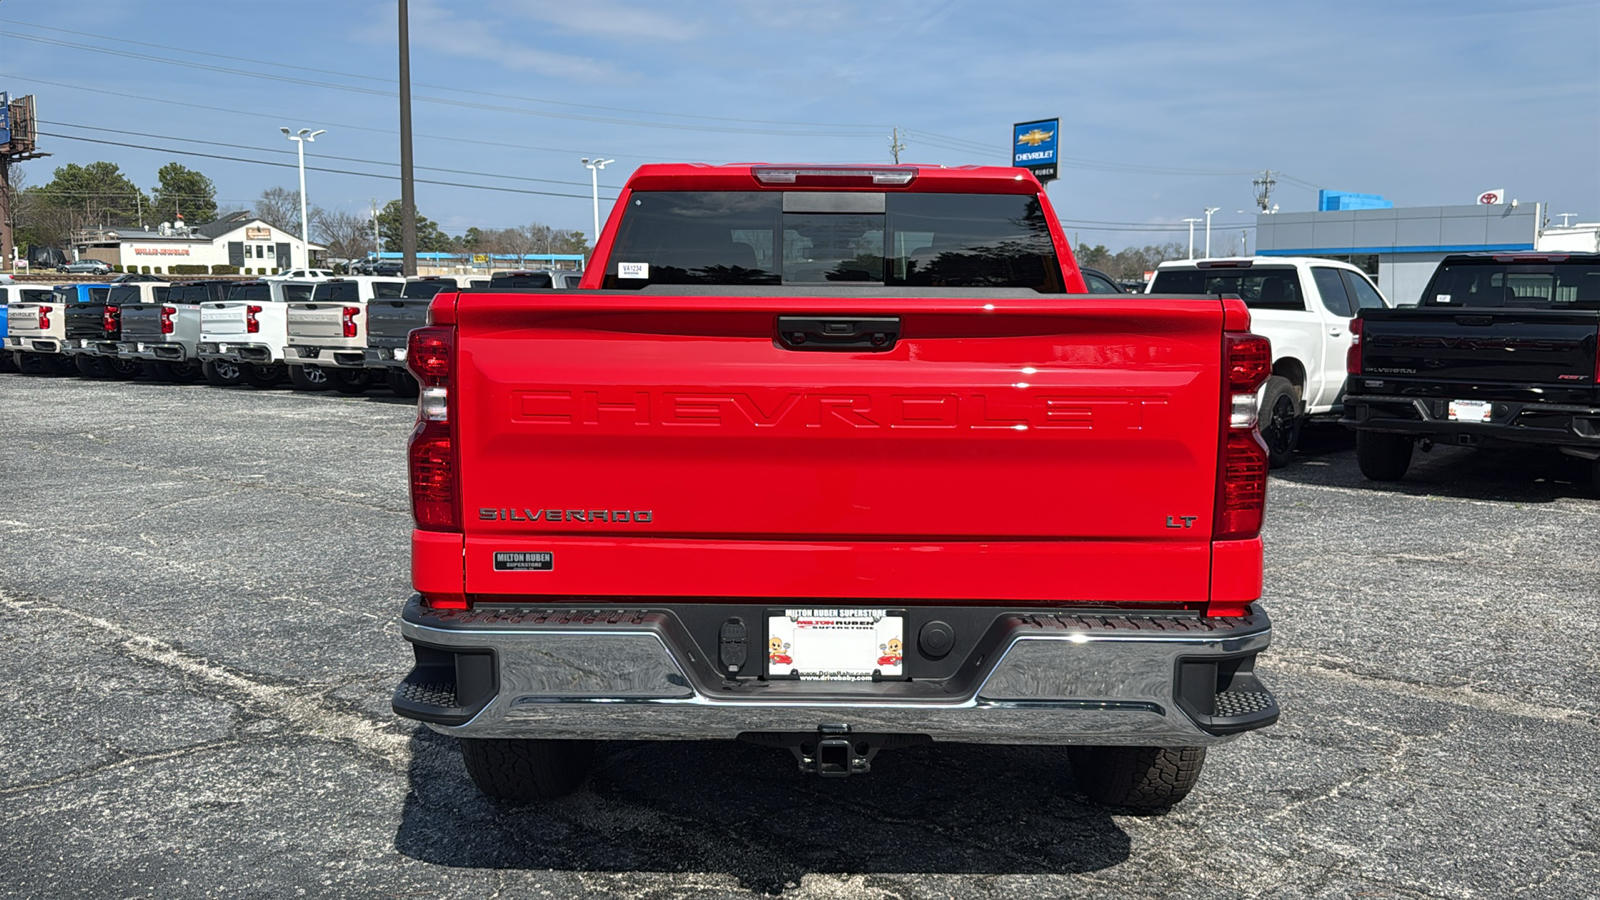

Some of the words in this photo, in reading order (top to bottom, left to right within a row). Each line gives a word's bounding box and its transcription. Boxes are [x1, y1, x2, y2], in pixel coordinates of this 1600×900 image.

[1015, 150, 1053, 161] CHEVROLET
[1034, 168, 1054, 176] RUBEN
[510, 389, 1168, 430] CHEVROLET
[479, 508, 653, 522] SILVERADO
[1166, 515, 1198, 529] LT
[497, 553, 524, 562] MILTON
[525, 553, 550, 562] RUBEN
[785, 609, 812, 617] MILTON
[813, 609, 838, 617] RUBEN
[839, 609, 887, 617] SUPERSTORE
